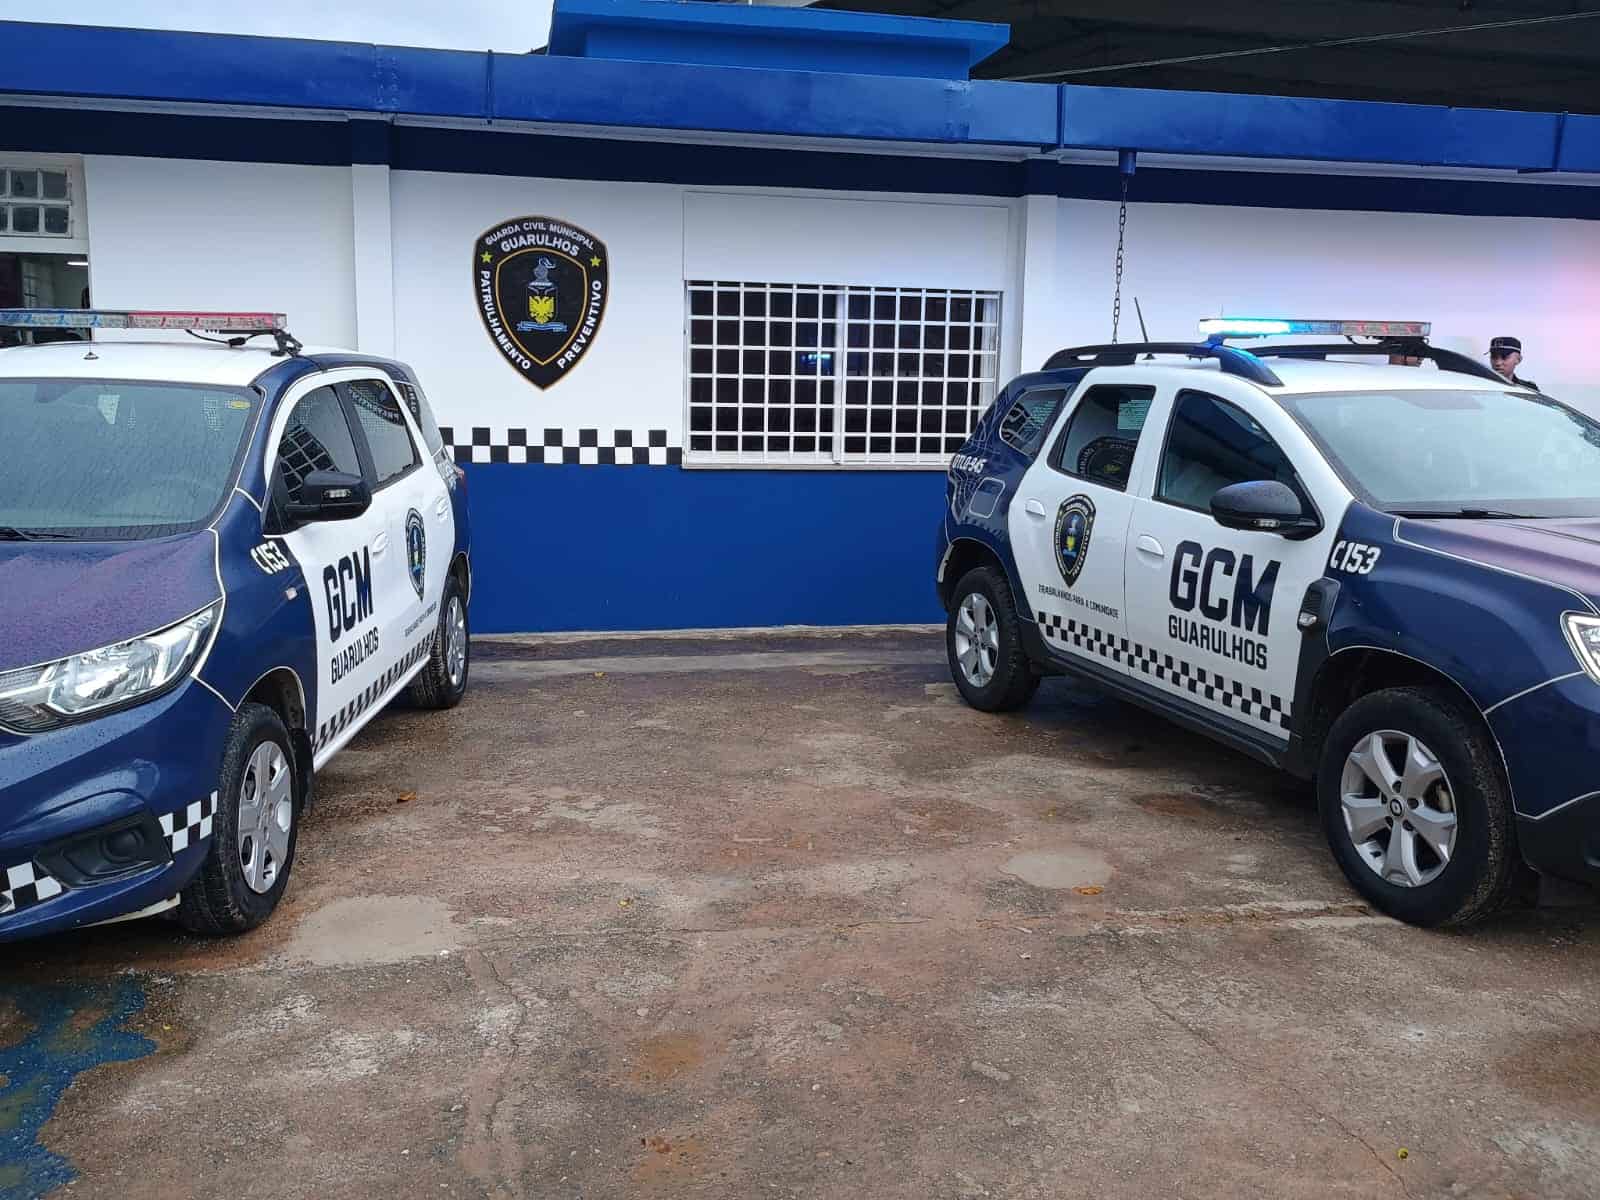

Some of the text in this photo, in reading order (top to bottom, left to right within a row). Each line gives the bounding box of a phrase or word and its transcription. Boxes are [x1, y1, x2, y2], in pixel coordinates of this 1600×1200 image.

[485, 222, 594, 250] GUARDA CIVIL MUNICIPAL
[501, 234, 580, 256] GUARULHOS
[480, 270, 531, 370] PATRULHAMENTO
[556, 280, 602, 369] PREVENTIVO
[323, 545, 374, 643] GCM
[1169, 540, 1281, 636] GCM
[331, 626, 379, 684] GUARULHOS
[1169, 614, 1267, 669] GUARULHOS
